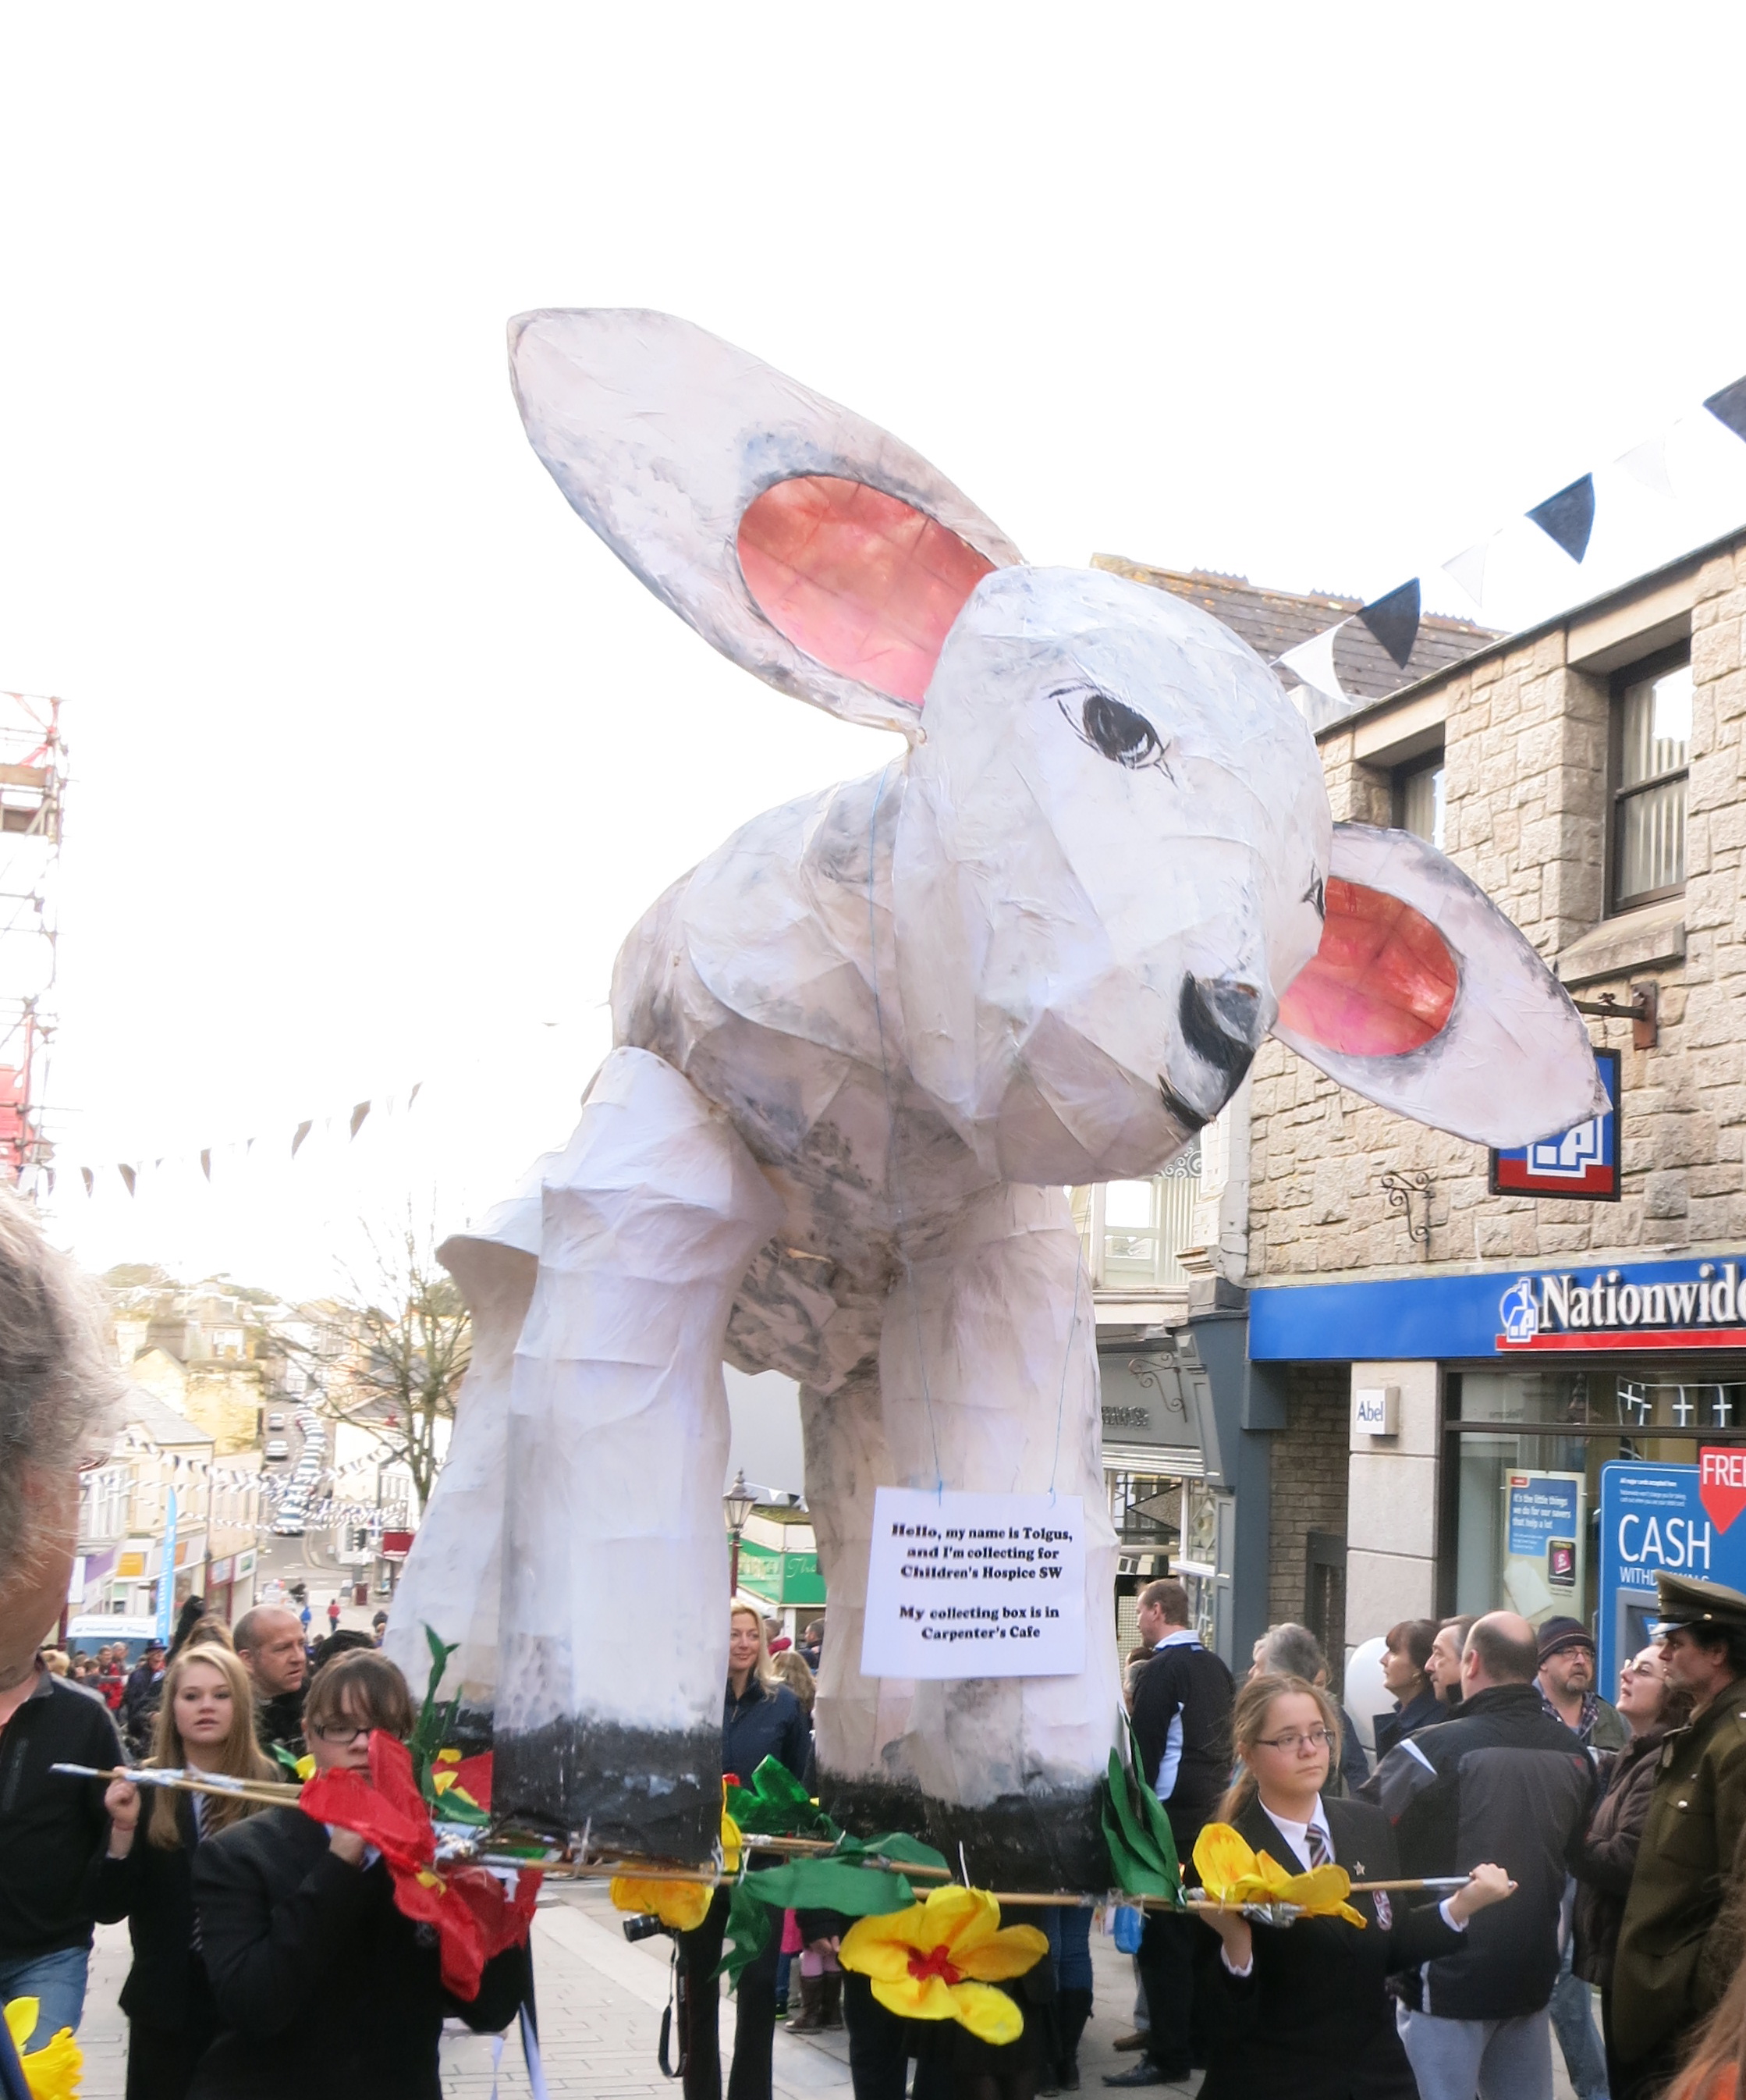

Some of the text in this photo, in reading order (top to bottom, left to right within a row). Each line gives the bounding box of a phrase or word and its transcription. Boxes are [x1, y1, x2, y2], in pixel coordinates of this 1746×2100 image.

[1357, 1401, 1384, 1422] Abel
[892, 1523, 1073, 1542] Hello, my name is Tolgus,
[1618, 1513, 1711, 1570] CASH
[907, 1547, 1060, 1562] and I'm collecting for
[900, 1565, 1063, 1582] Children's Hospice SW
[899, 1605, 1059, 1622] My collecting box is in
[921, 1626, 1041, 1643] Carpenter's Cafe
